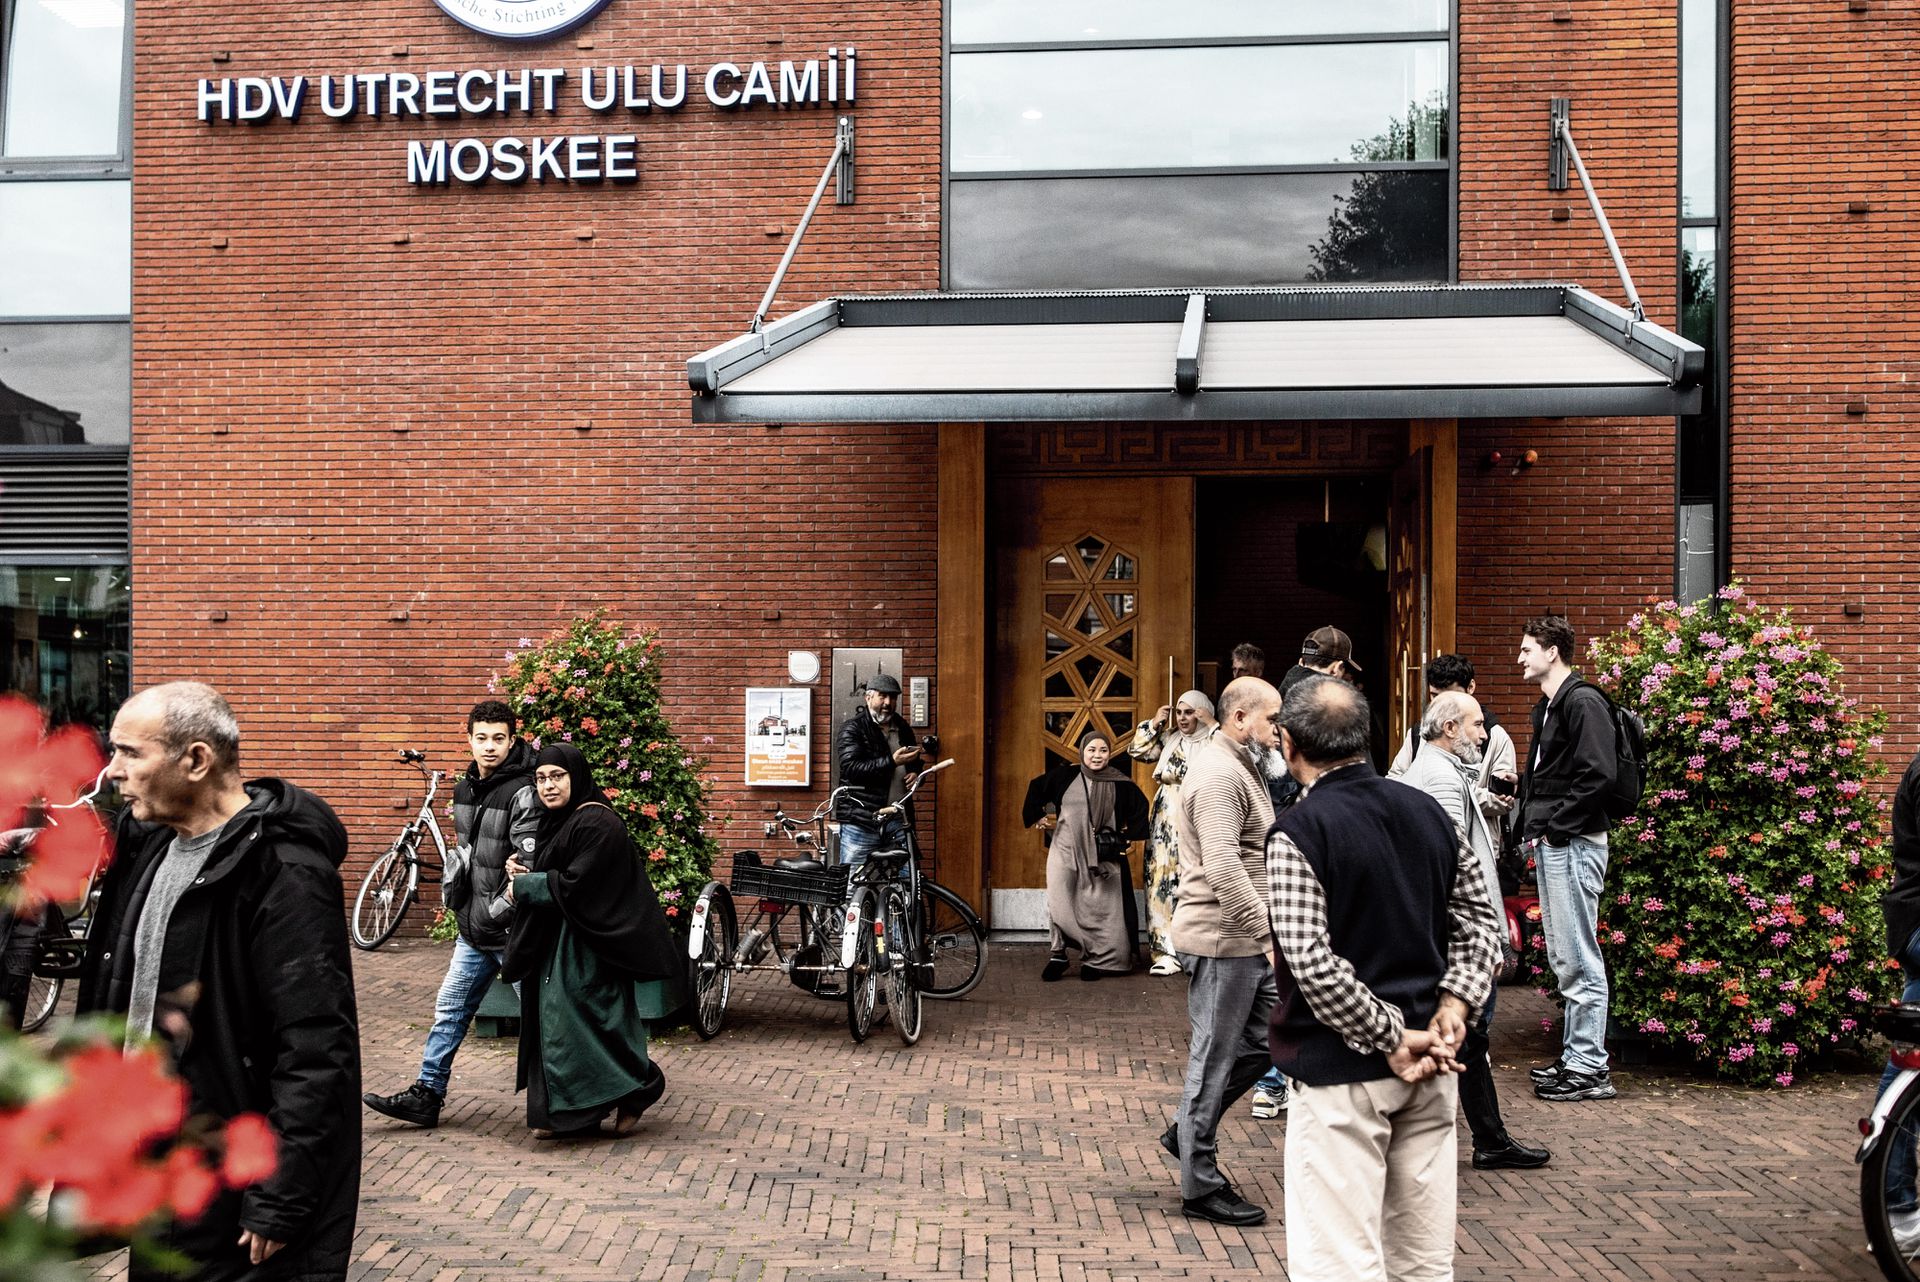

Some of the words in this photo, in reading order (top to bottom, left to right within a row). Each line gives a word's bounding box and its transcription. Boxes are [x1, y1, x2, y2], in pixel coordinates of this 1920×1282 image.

[493, 2, 567, 23] Stichting
[198, 76, 304, 120] HDV
[321, 68, 564, 118] UTRECHT
[582, 64, 686, 110] ULU
[407, 135, 637, 183] MOSKEE
